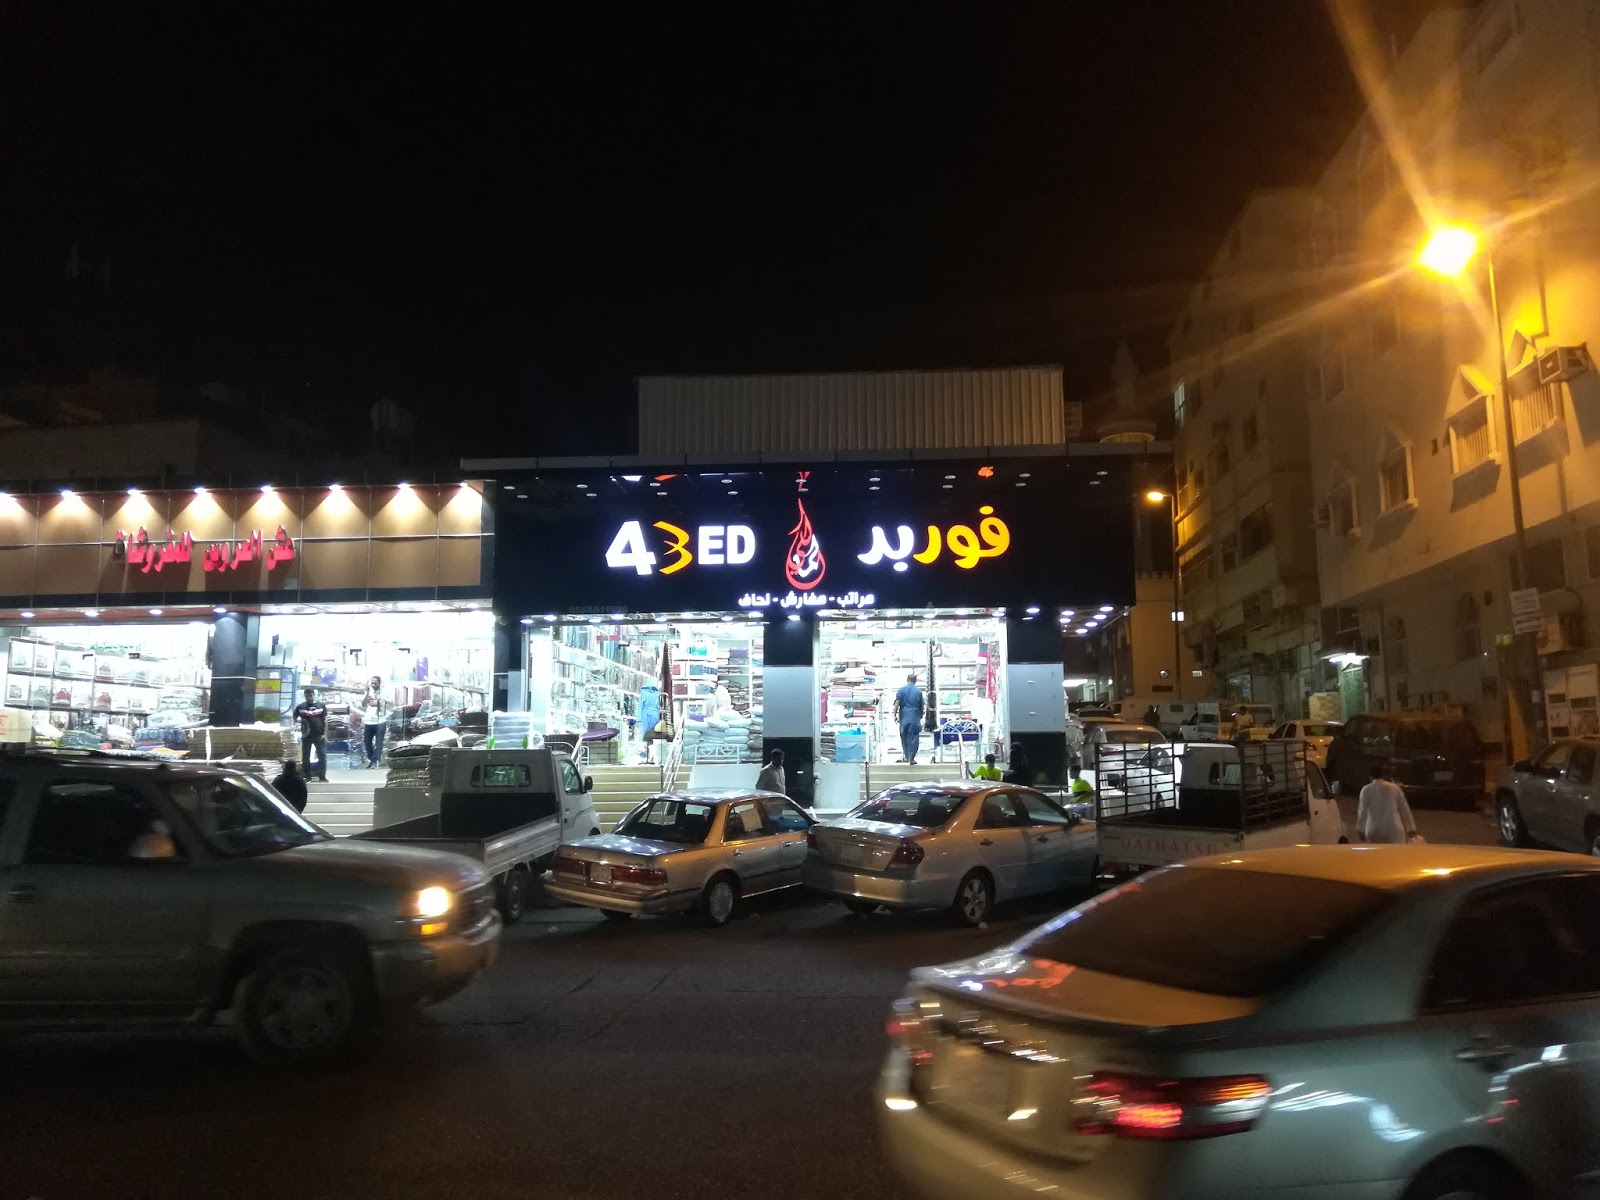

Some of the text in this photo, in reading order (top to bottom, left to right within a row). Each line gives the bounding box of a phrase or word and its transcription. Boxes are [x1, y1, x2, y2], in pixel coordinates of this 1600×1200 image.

[738, 592, 770, 607] لحاف
[780, 590, 827, 609] مفارش
[837, 591, 875, 608] مراتب
